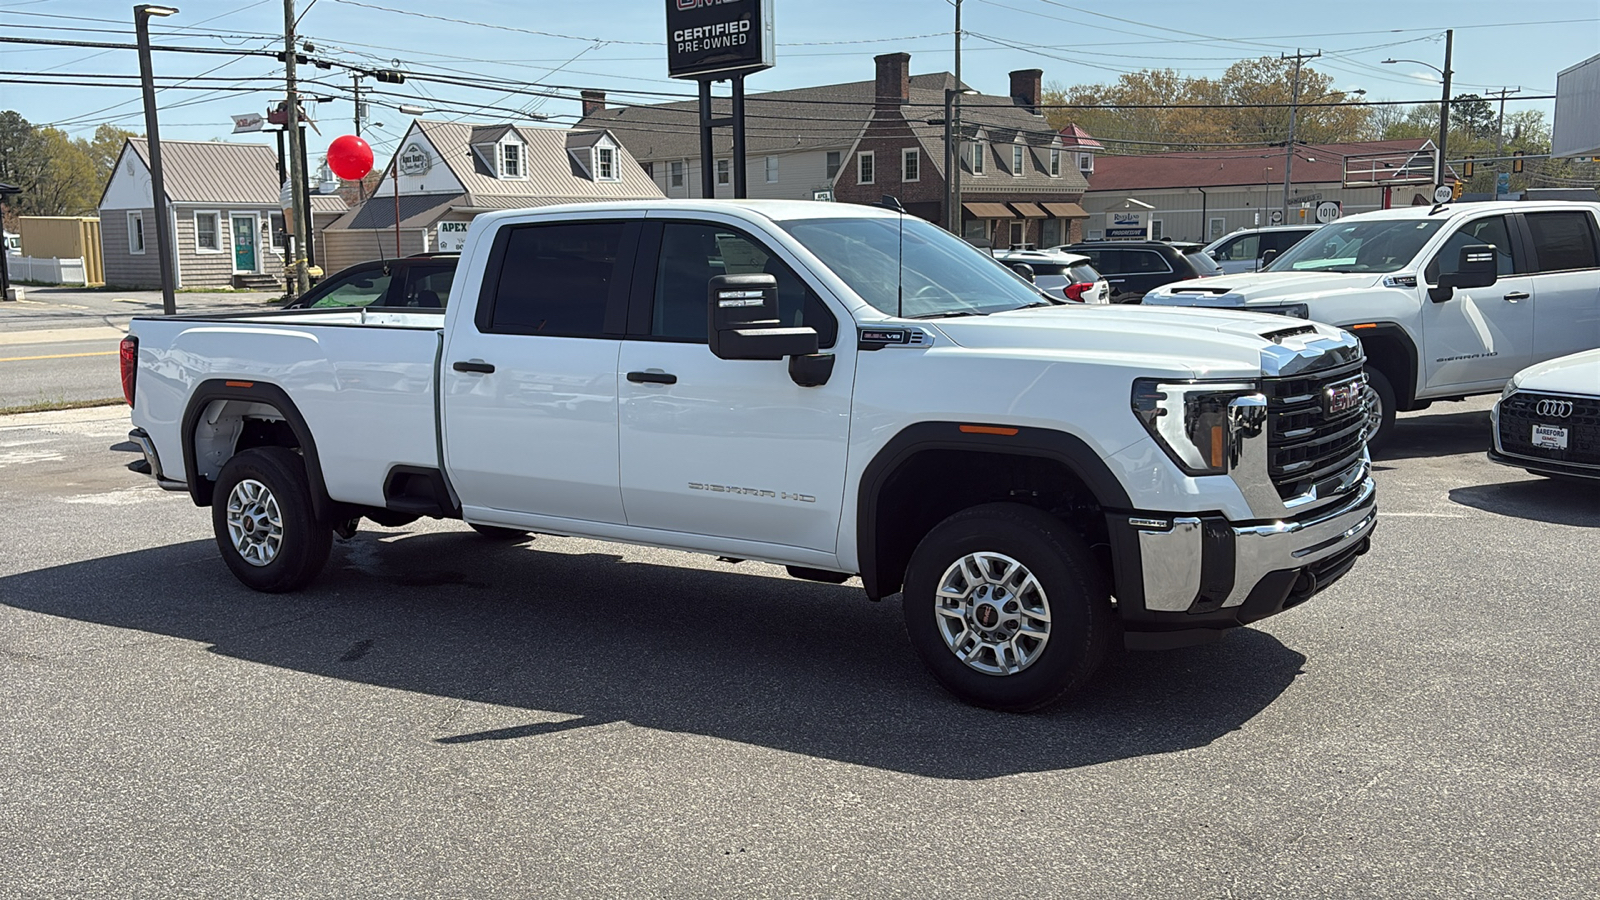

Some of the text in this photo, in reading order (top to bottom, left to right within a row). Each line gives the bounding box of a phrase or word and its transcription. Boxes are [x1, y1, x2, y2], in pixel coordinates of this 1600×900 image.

[674, 20, 750, 41] CERTIFIED
[678, 34, 747, 53] PRE-OWNED
[1319, 207, 1337, 218] 1010
[442, 222, 468, 232] APEX
[1436, 354, 1480, 362] SIERRA
[1535, 427, 1565, 438] BAREFORD
[687, 482, 816, 503] SIERRA HD
